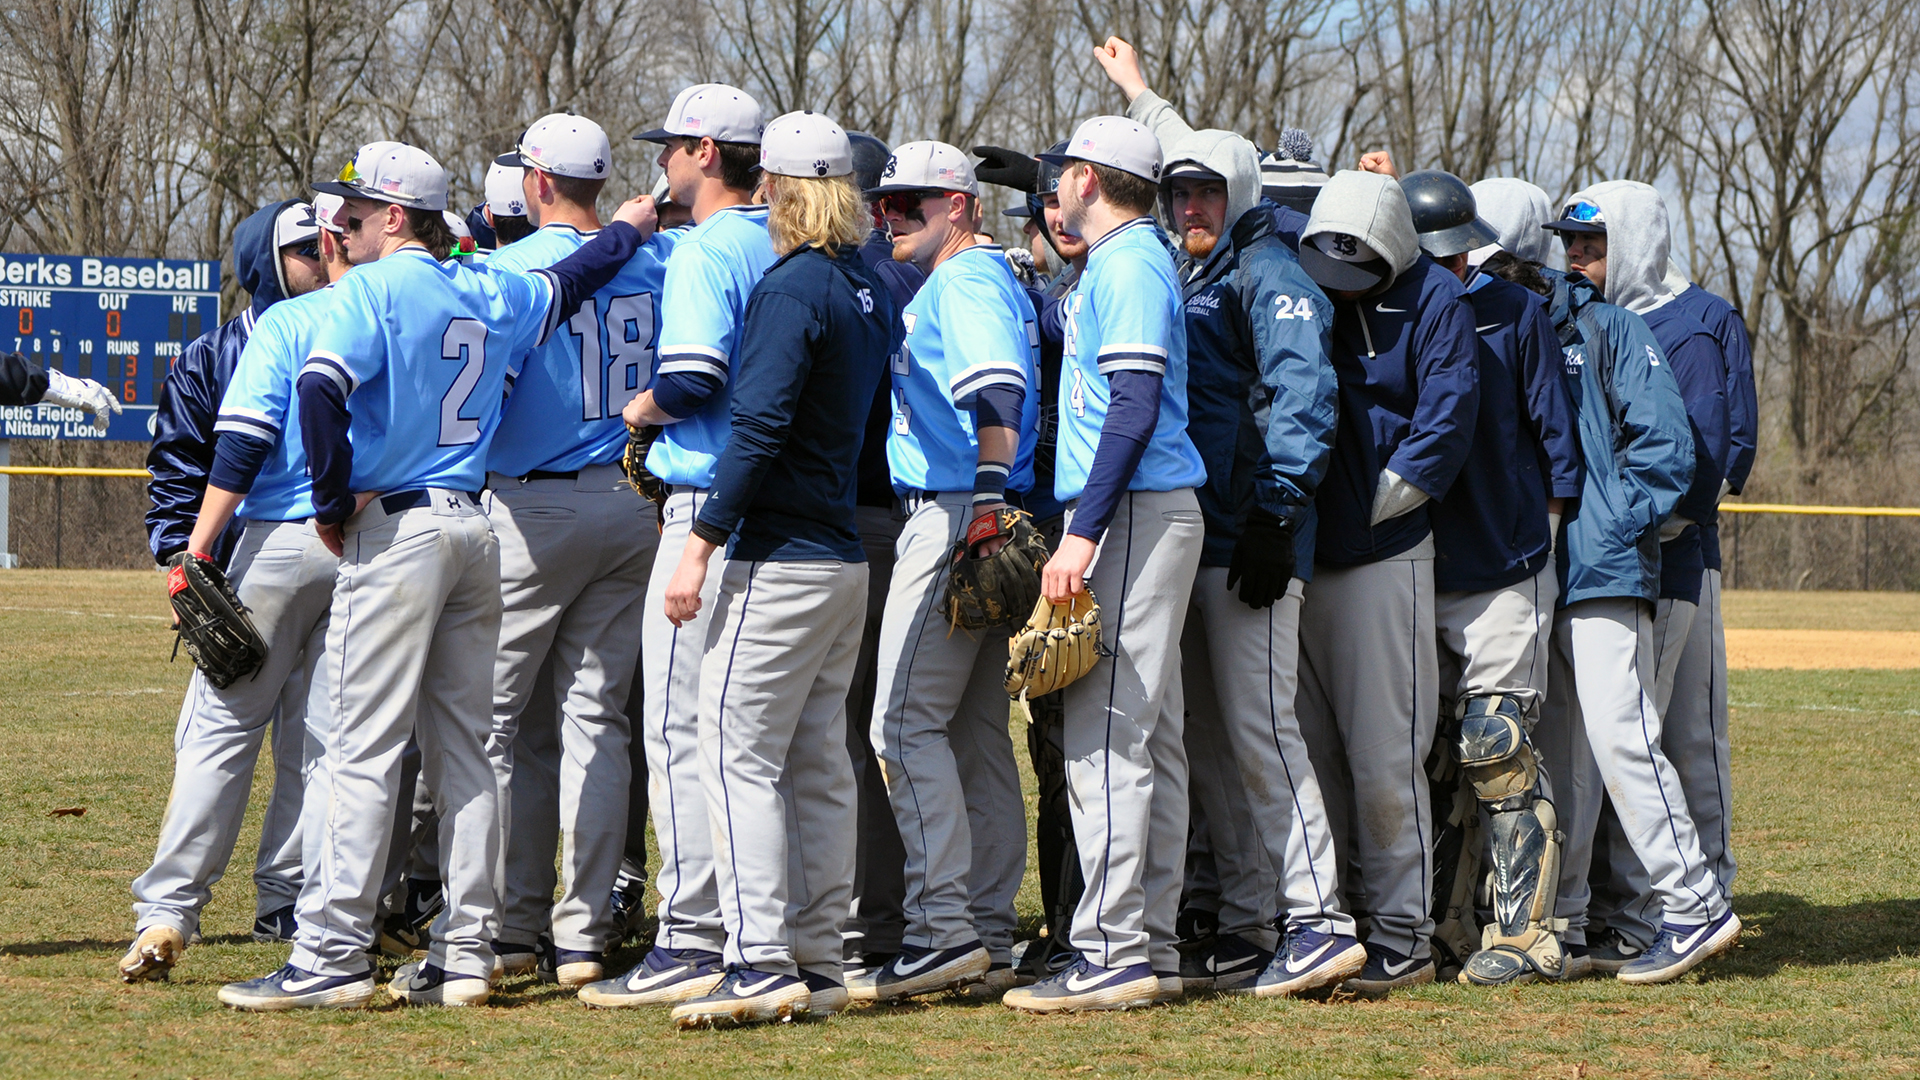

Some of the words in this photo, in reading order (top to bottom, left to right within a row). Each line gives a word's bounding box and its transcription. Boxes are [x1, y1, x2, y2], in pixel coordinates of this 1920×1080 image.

[0, 255, 72, 286] erks
[82, 258, 209, 290] Baseball
[0, 289, 51, 308] STRIKE
[98, 292, 129, 311] OUT
[172, 295, 198, 314] H/E
[856, 288, 874, 314] 15
[1274, 294, 1313, 321] 24
[19, 308, 33, 335] 0
[106, 311, 121, 338] 0
[14, 337, 23, 352] 7
[33, 338, 41, 352] 8
[52, 338, 60, 353] 9
[78, 339, 93, 354] 10
[106, 340, 140, 356] RUNS
[154, 341, 182, 356] HITS
[568, 290, 657, 422] 18
[1645, 344, 1660, 367] 6
[126, 355, 138, 377] 3
[124, 380, 137, 402] 6
[436, 316, 488, 448] 2
[1070, 368, 1086, 418] 4
[37, 407, 84, 423] Fields
[5, 421, 60, 440] Nittany
